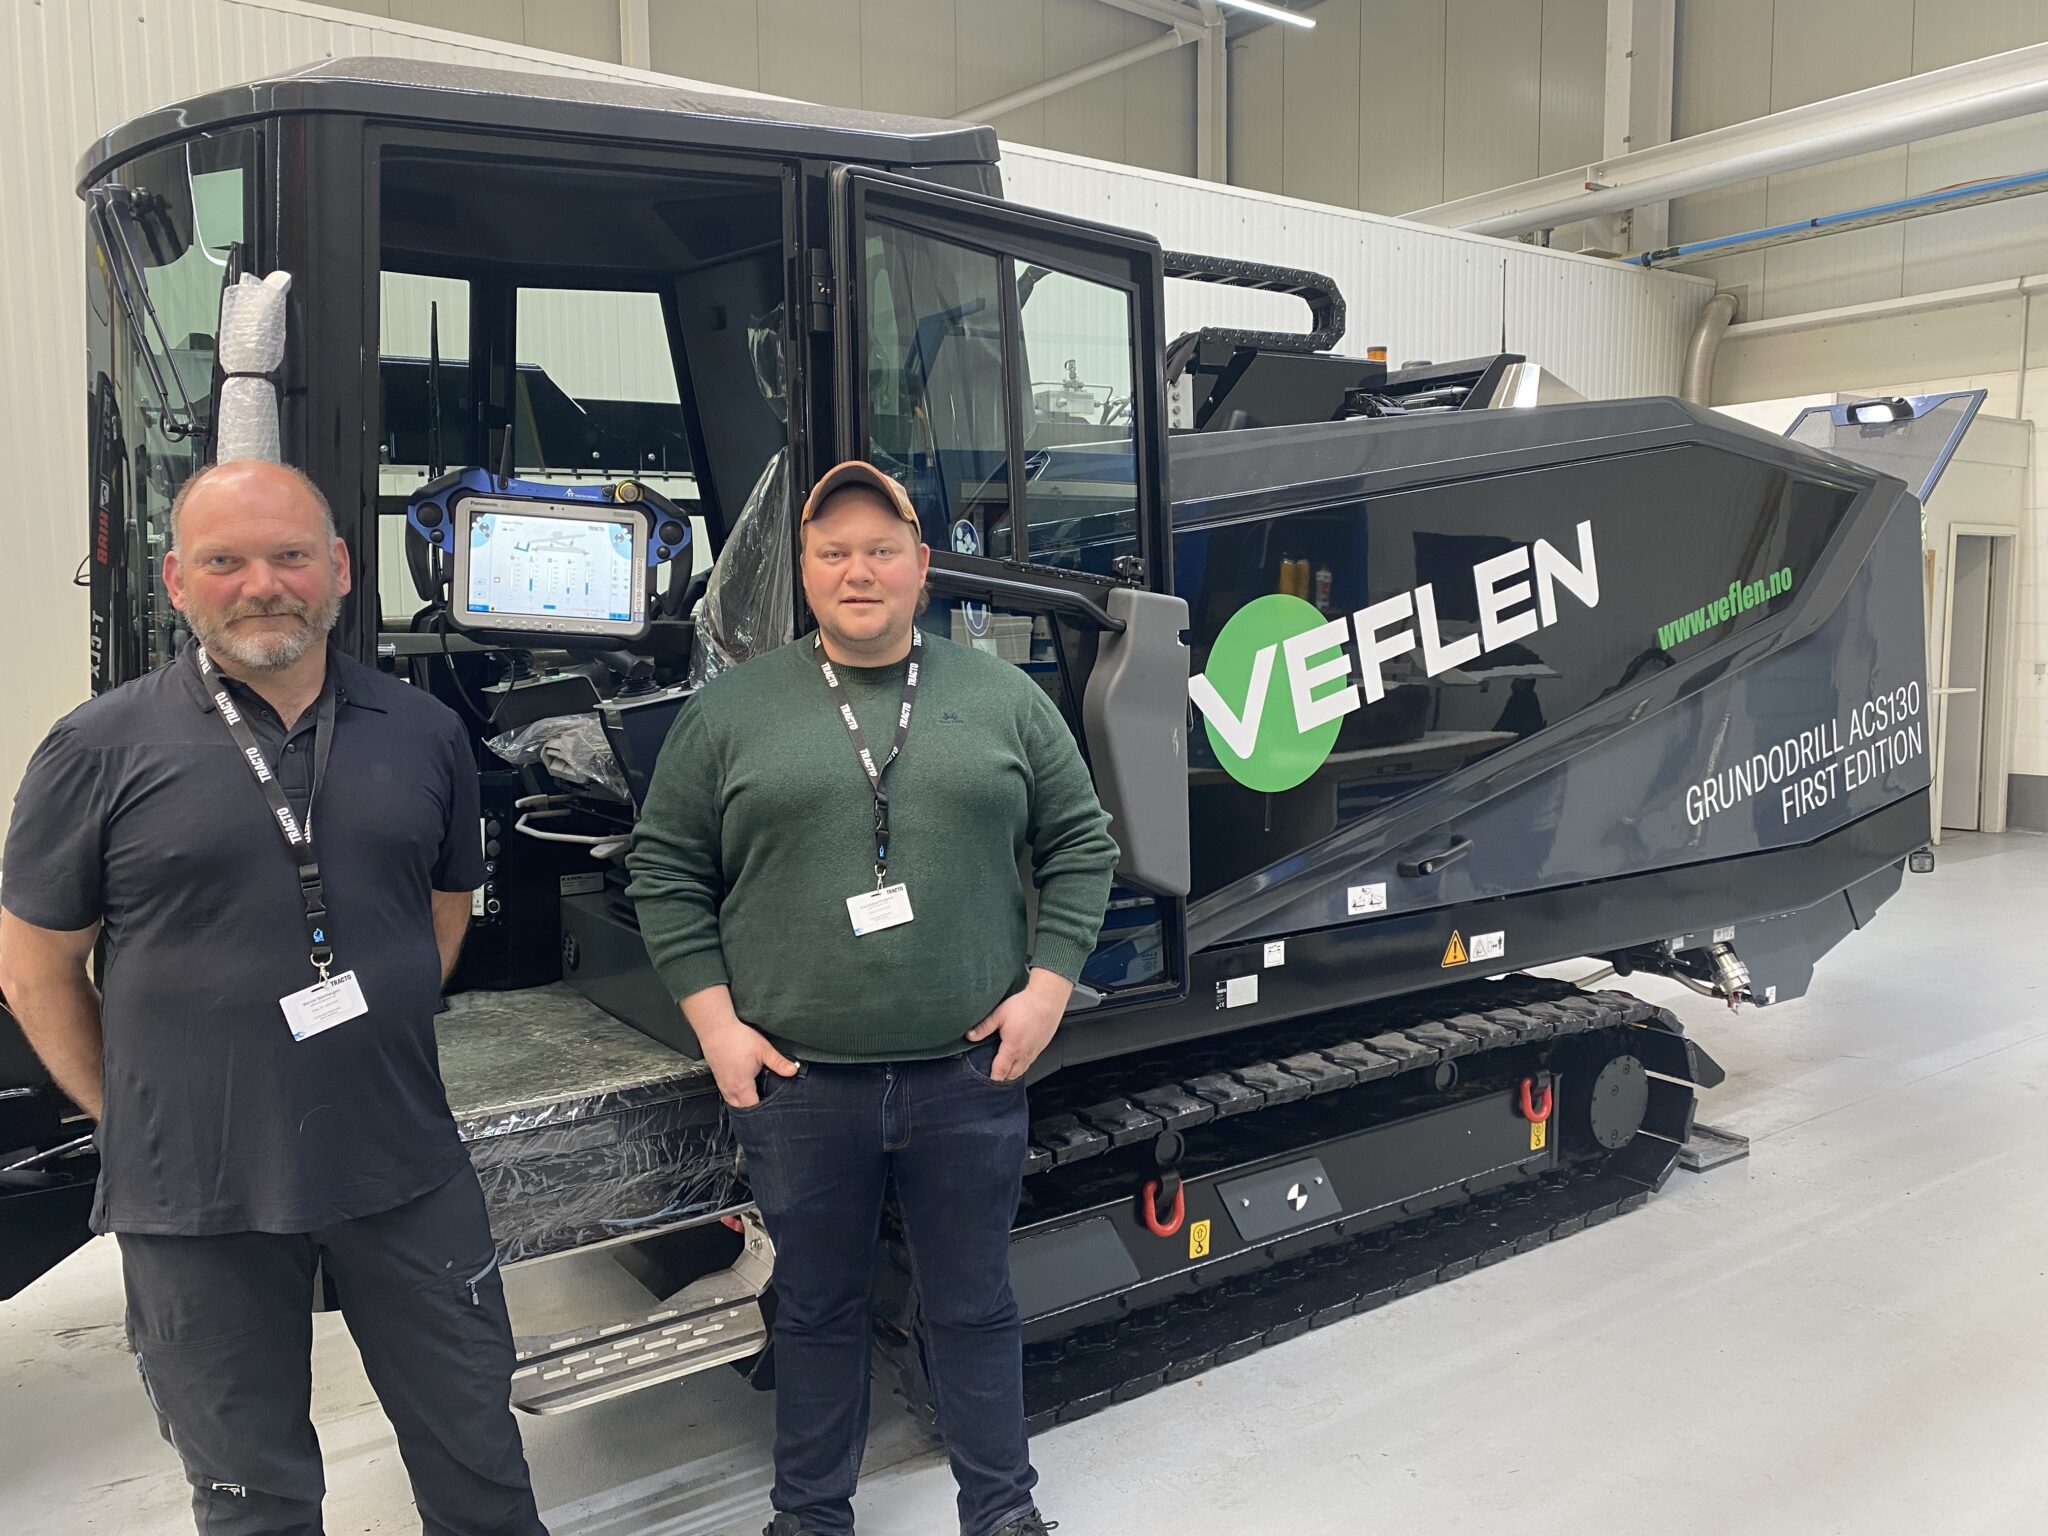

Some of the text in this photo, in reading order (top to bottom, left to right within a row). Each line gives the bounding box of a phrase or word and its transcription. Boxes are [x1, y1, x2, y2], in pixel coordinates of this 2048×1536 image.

[1657, 567, 1792, 650] www.veflen.no
[1188, 520, 1599, 759] VEFLEN
[821, 661, 839, 688] TRACTO
[907, 662, 919, 687] TRACTO
[214, 691, 240, 726] TRACTO
[840, 703, 859, 731] TRACTO
[899, 702, 912, 729] TRACTO
[245, 747, 272, 783] TRACTO
[859, 748, 878, 777] TRACTO
[1686, 681, 1920, 826] GRUNDODRILL ACS130
[1781, 722, 1922, 824] FIRST EDITION
[276, 807, 302, 845] TRACTO
[330, 974, 352, 987] TRACTO
